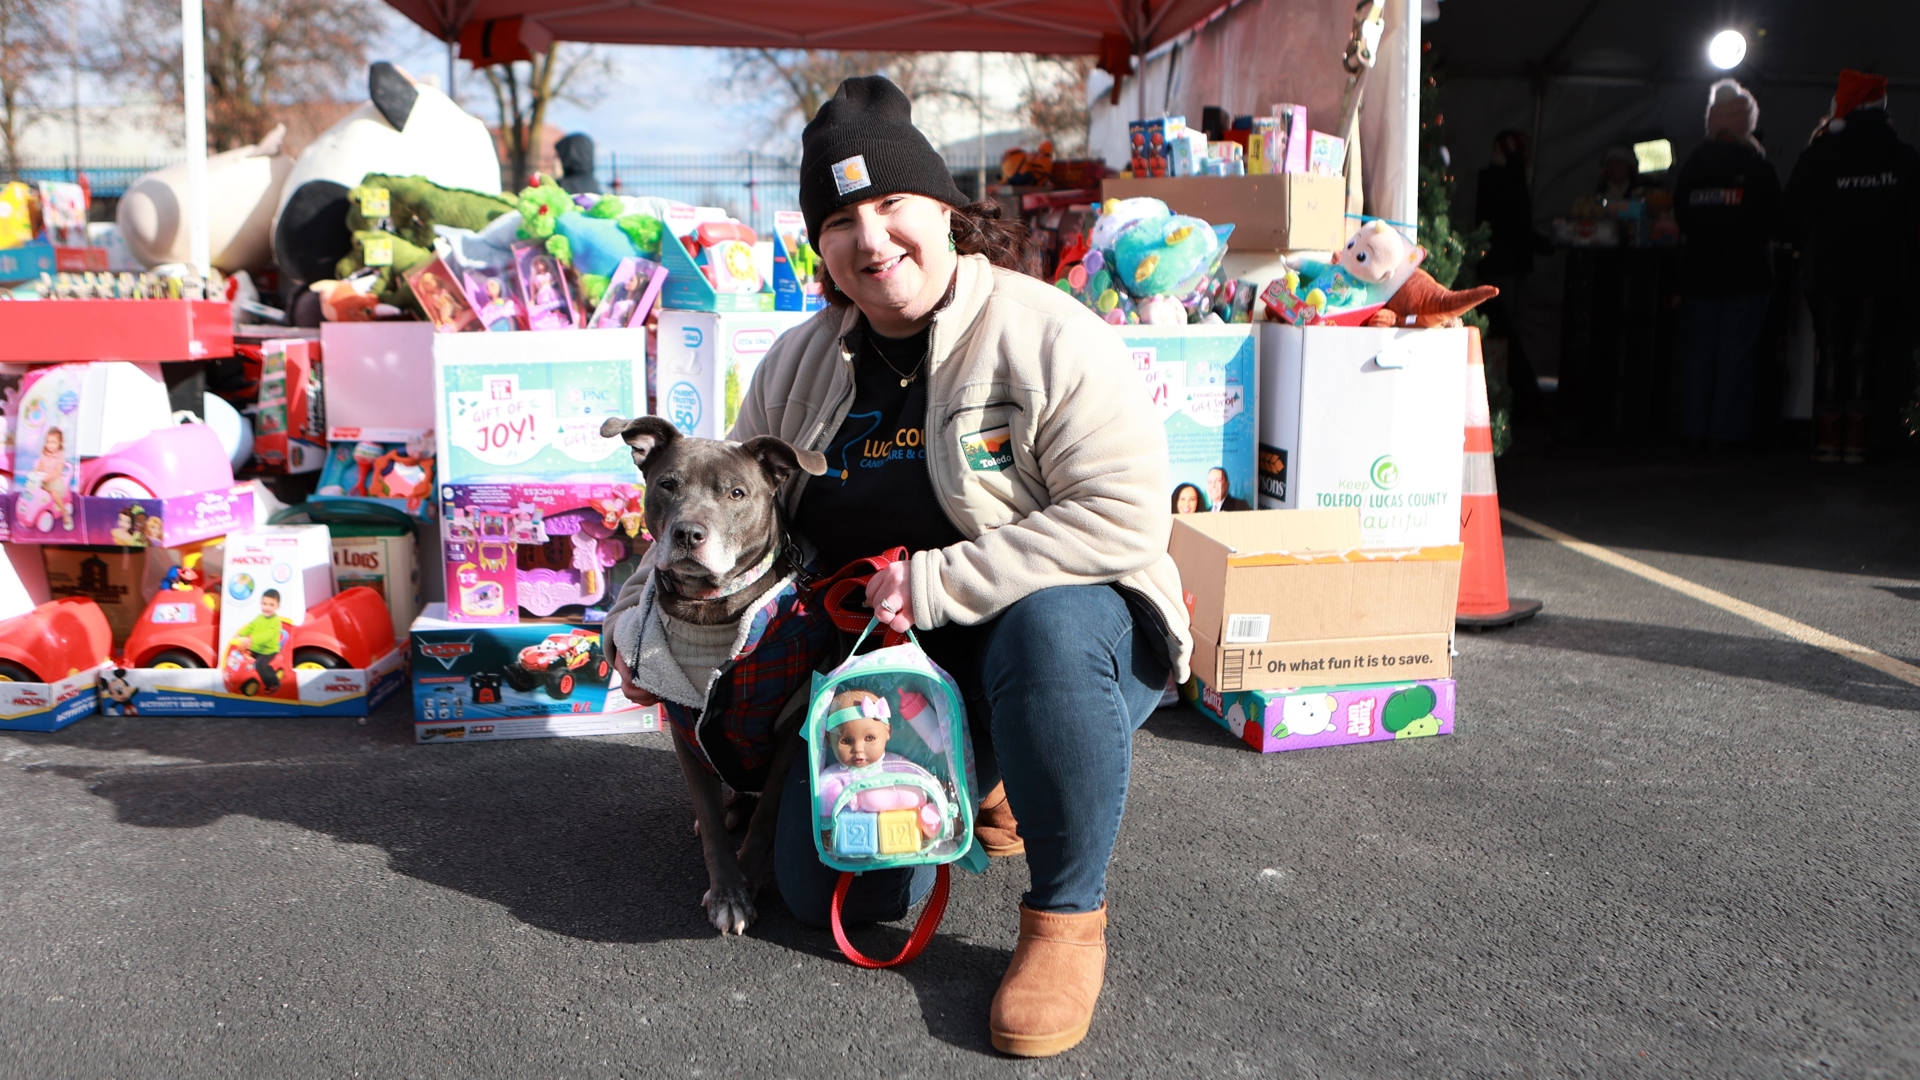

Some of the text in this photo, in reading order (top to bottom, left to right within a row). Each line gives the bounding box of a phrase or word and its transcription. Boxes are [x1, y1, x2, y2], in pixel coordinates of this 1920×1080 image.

[1209, 361, 1233, 372] PNC
[582, 390, 610, 401] PNC
[473, 401, 524, 423] GIFT OF
[476, 414, 536, 452] JOY!
[980, 455, 1012, 468] Toledo
[523, 487, 565, 496] PRINCESS
[1338, 479, 1370, 492] Keep
[1407, 491, 1448, 507] COUNTY
[1363, 511, 1428, 533] autiful
[1267, 653, 1433, 673] Oh what fun it is to save.
[572, 702, 592, 713] R/C
[849, 826, 866, 844] 2
